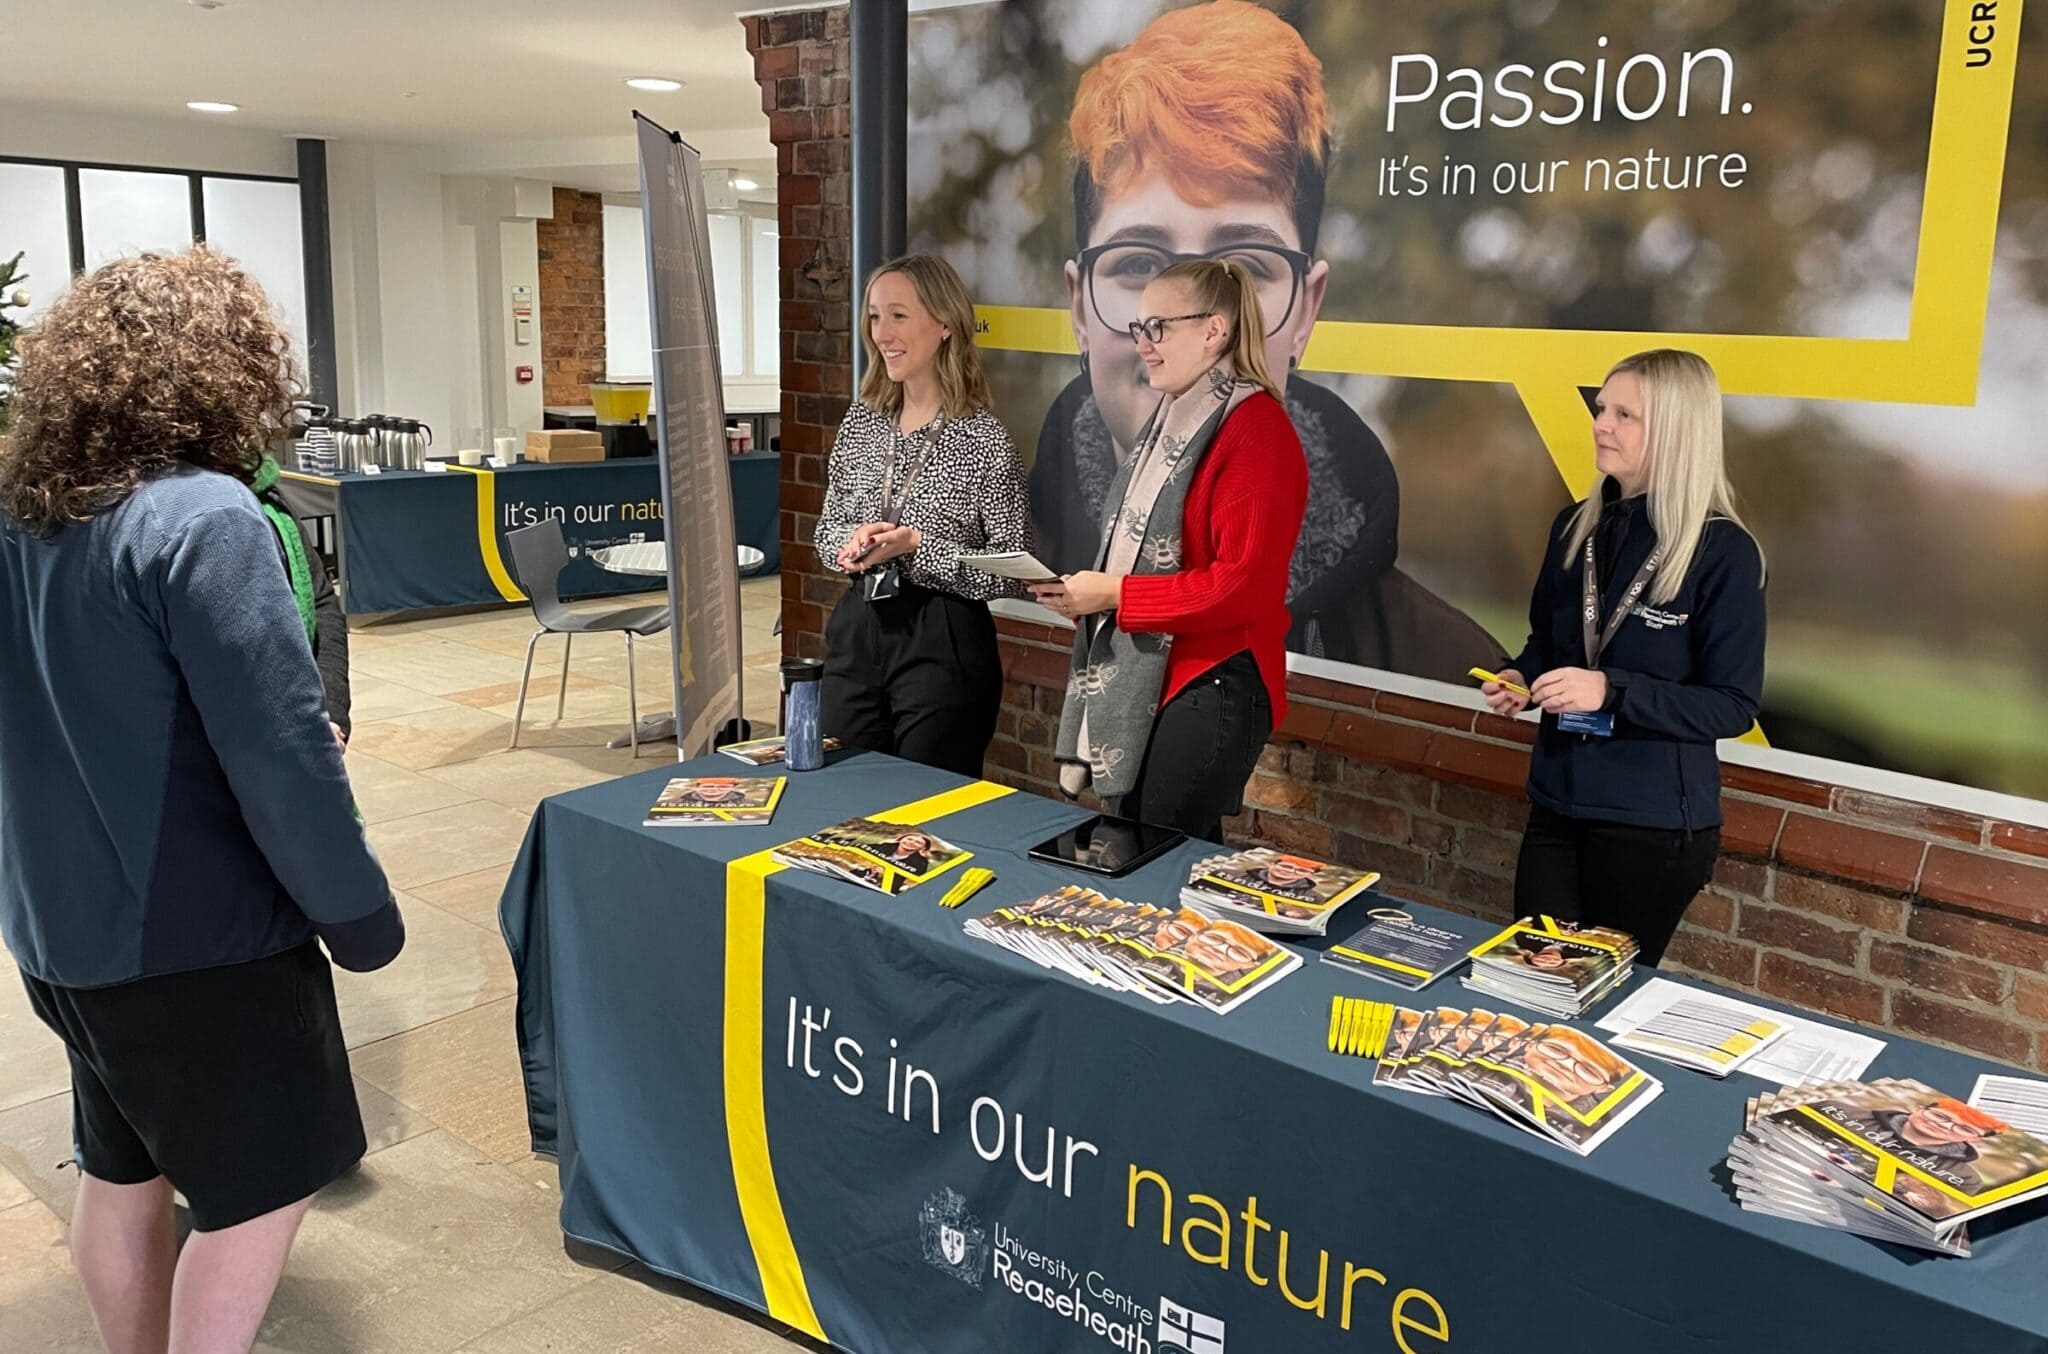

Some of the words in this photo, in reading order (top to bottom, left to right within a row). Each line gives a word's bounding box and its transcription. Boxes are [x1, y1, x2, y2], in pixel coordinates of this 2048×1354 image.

[1966, 1, 1998, 67] UCR
[1386, 35, 1752, 132] Passion.
[1378, 154, 1429, 196] It's
[1442, 155, 1476, 195] in
[1492, 159, 1571, 194] our
[1584, 148, 1748, 192] nature
[504, 501, 538, 527] It's
[544, 501, 566, 524] in
[574, 504, 615, 524] our
[787, 996, 864, 1096] It's
[887, 1018, 940, 1134] in
[970, 1096, 1098, 1198] our
[1127, 1163, 1449, 1354] nature
[1821, 1105, 1848, 1121] It's
[1845, 1119, 1865, 1131] in
[1865, 1131, 1902, 1149] our
[1898, 1150, 1964, 1186] nature
[994, 1249, 1151, 1354] Reaseheath
[995, 1222, 1079, 1289] University
[1086, 1271, 1153, 1325] Centre
